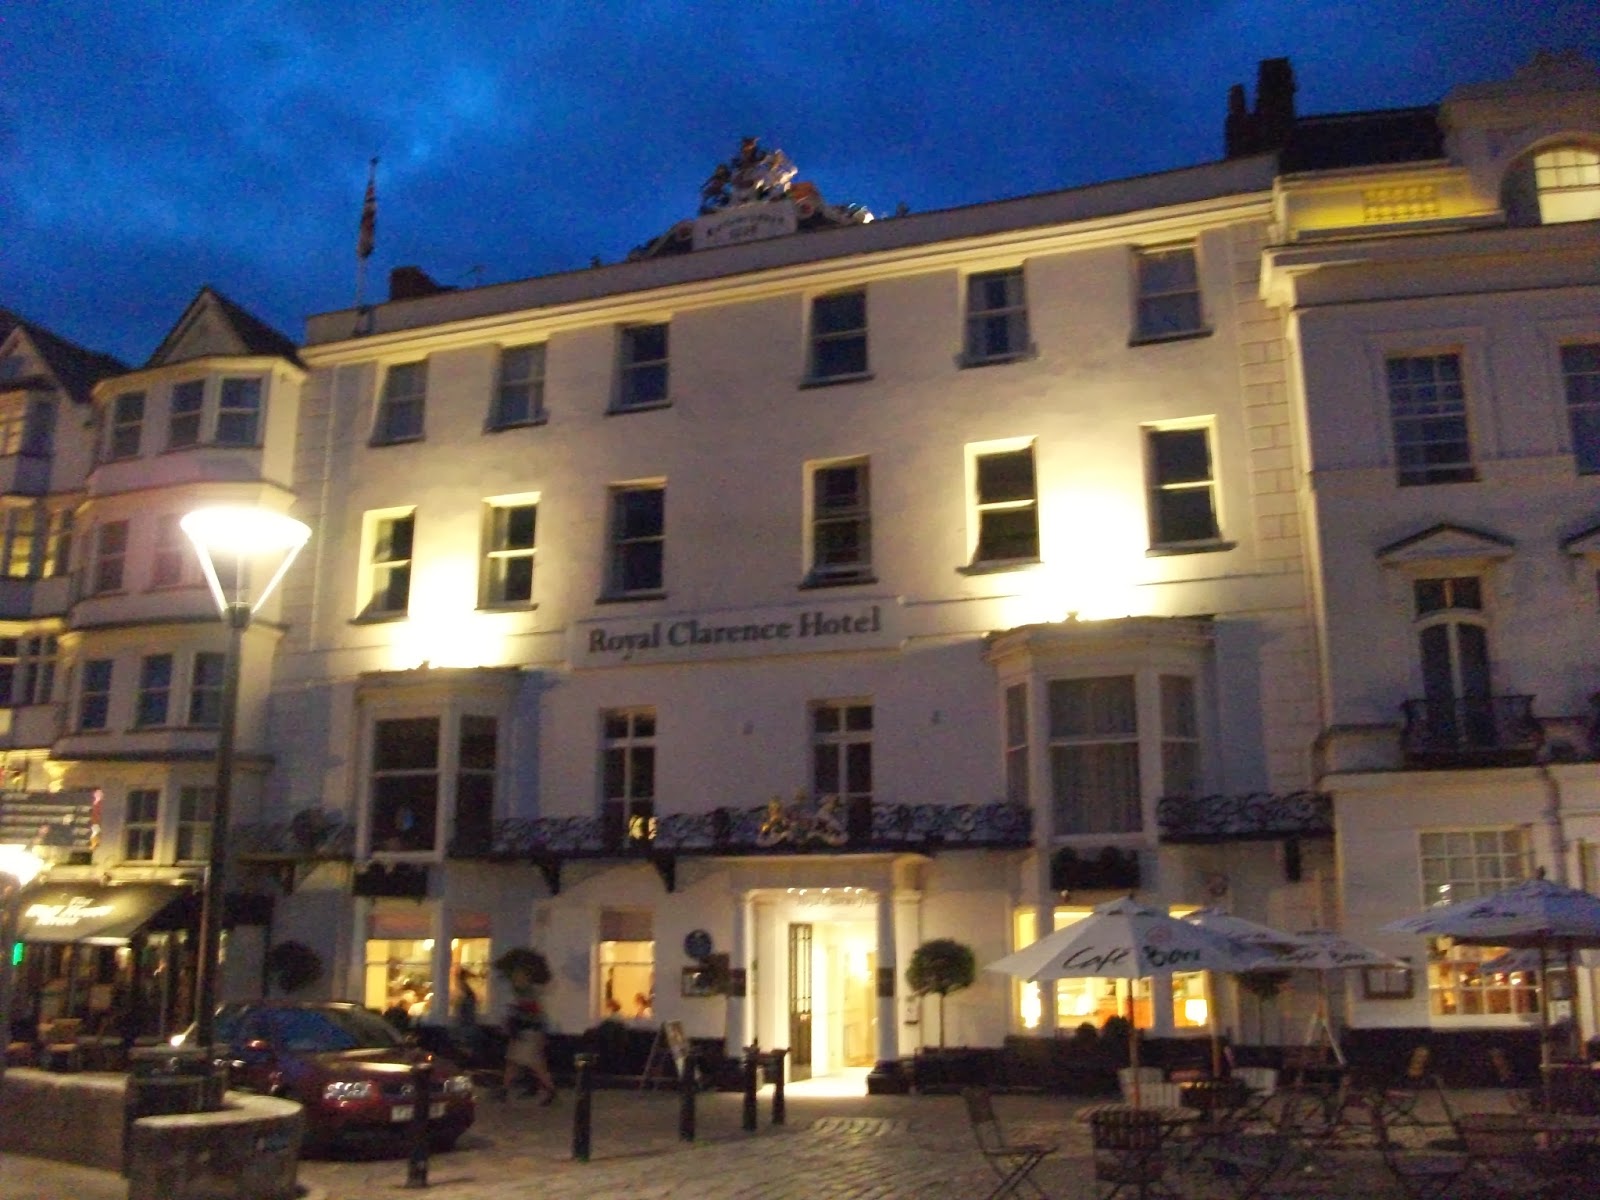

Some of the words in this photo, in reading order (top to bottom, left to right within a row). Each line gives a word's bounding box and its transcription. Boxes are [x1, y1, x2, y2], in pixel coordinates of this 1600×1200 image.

[589, 622, 661, 661] Royal
[667, 619, 793, 648] Clarence
[799, 605, 880, 637] Hotel
